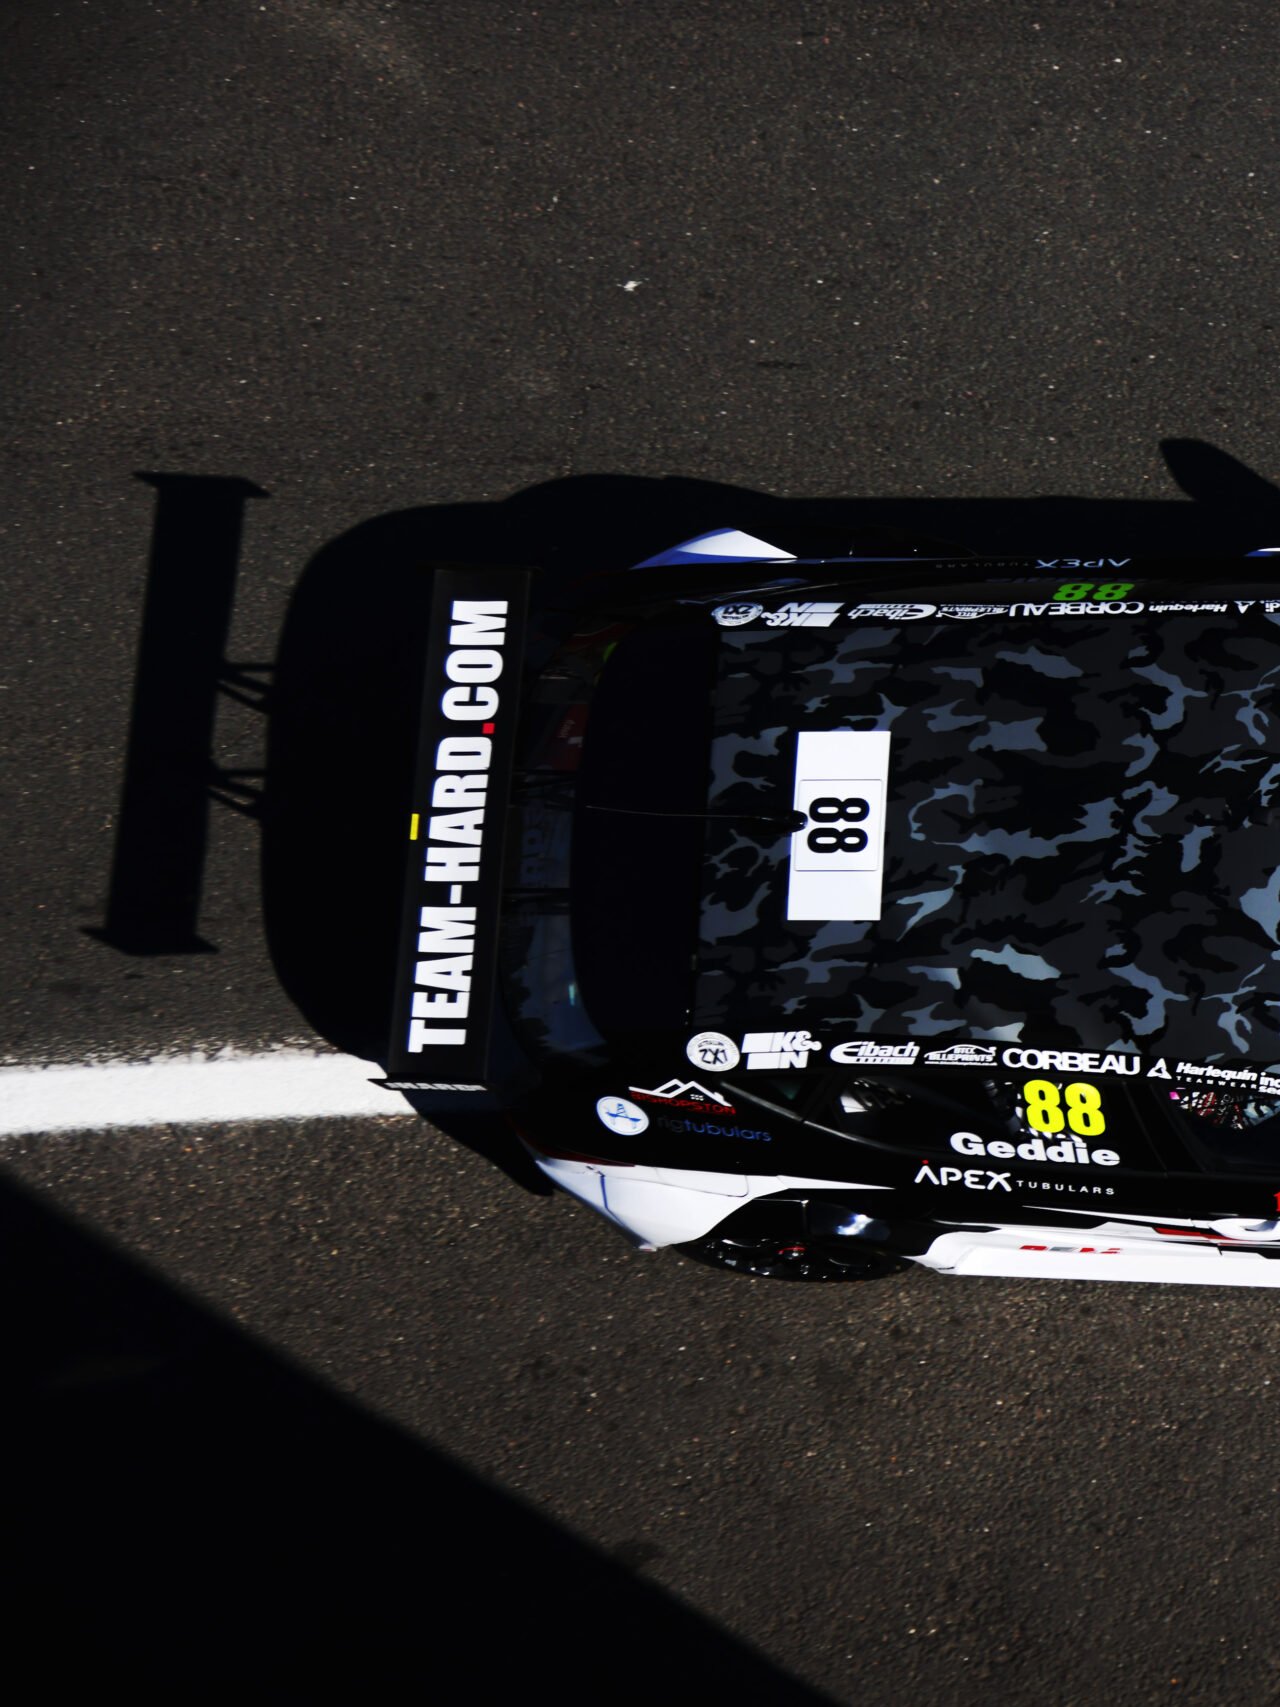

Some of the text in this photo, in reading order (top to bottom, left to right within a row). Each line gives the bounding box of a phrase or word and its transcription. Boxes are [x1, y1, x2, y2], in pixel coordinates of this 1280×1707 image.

[1052, 583, 1135, 601] 88
[848, 604, 936, 620] Eibach
[1009, 601, 1145, 617] CORBEAU
[1149, 603, 1229, 614] Harlequin
[408, 600, 508, 1053] TEAM-HARD.COM
[807, 796, 870, 854] 88
[830, 1041, 920, 1065] Eibach
[1002, 1048, 1140, 1075] CORBEAU
[1176, 1061, 1258, 1081] Harlequin
[1023, 1079, 1106, 1136] 88
[950, 1132, 1121, 1166] Geddie
[914, 1160, 1115, 1195] APEX TUBULARS
